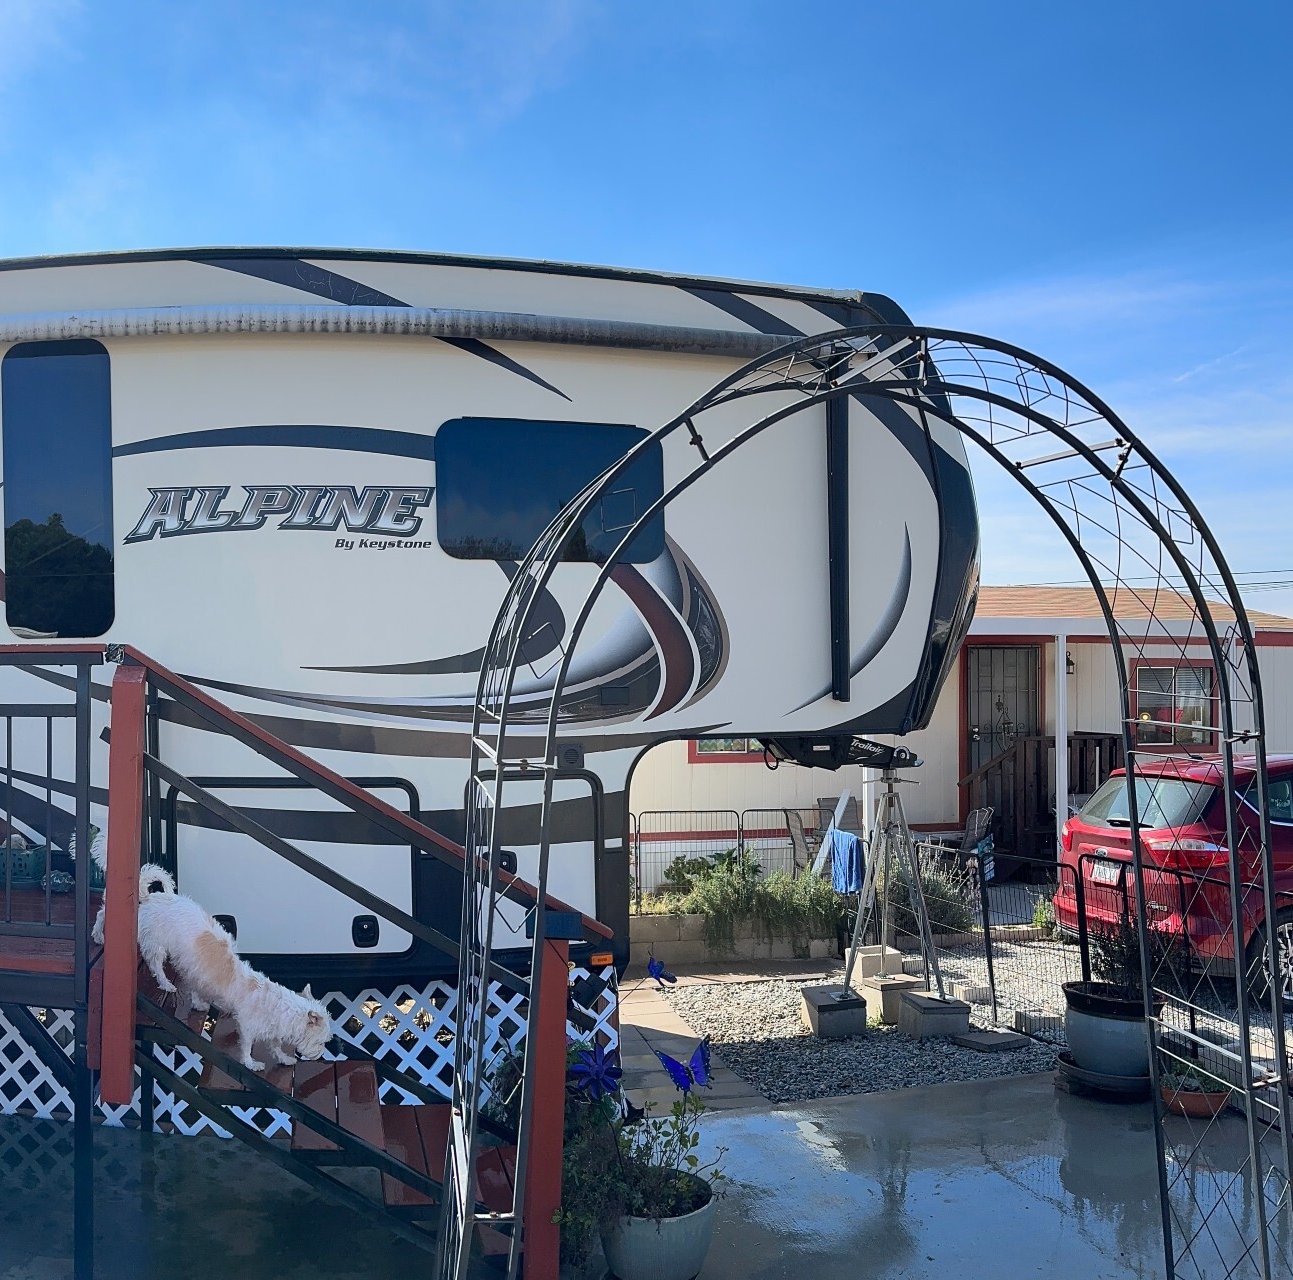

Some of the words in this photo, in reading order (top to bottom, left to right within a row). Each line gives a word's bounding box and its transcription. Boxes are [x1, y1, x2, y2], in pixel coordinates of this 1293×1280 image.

[123, 485, 435, 545] ALPINE
[334, 538, 355, 551] By
[358, 538, 432, 551] Keystone
